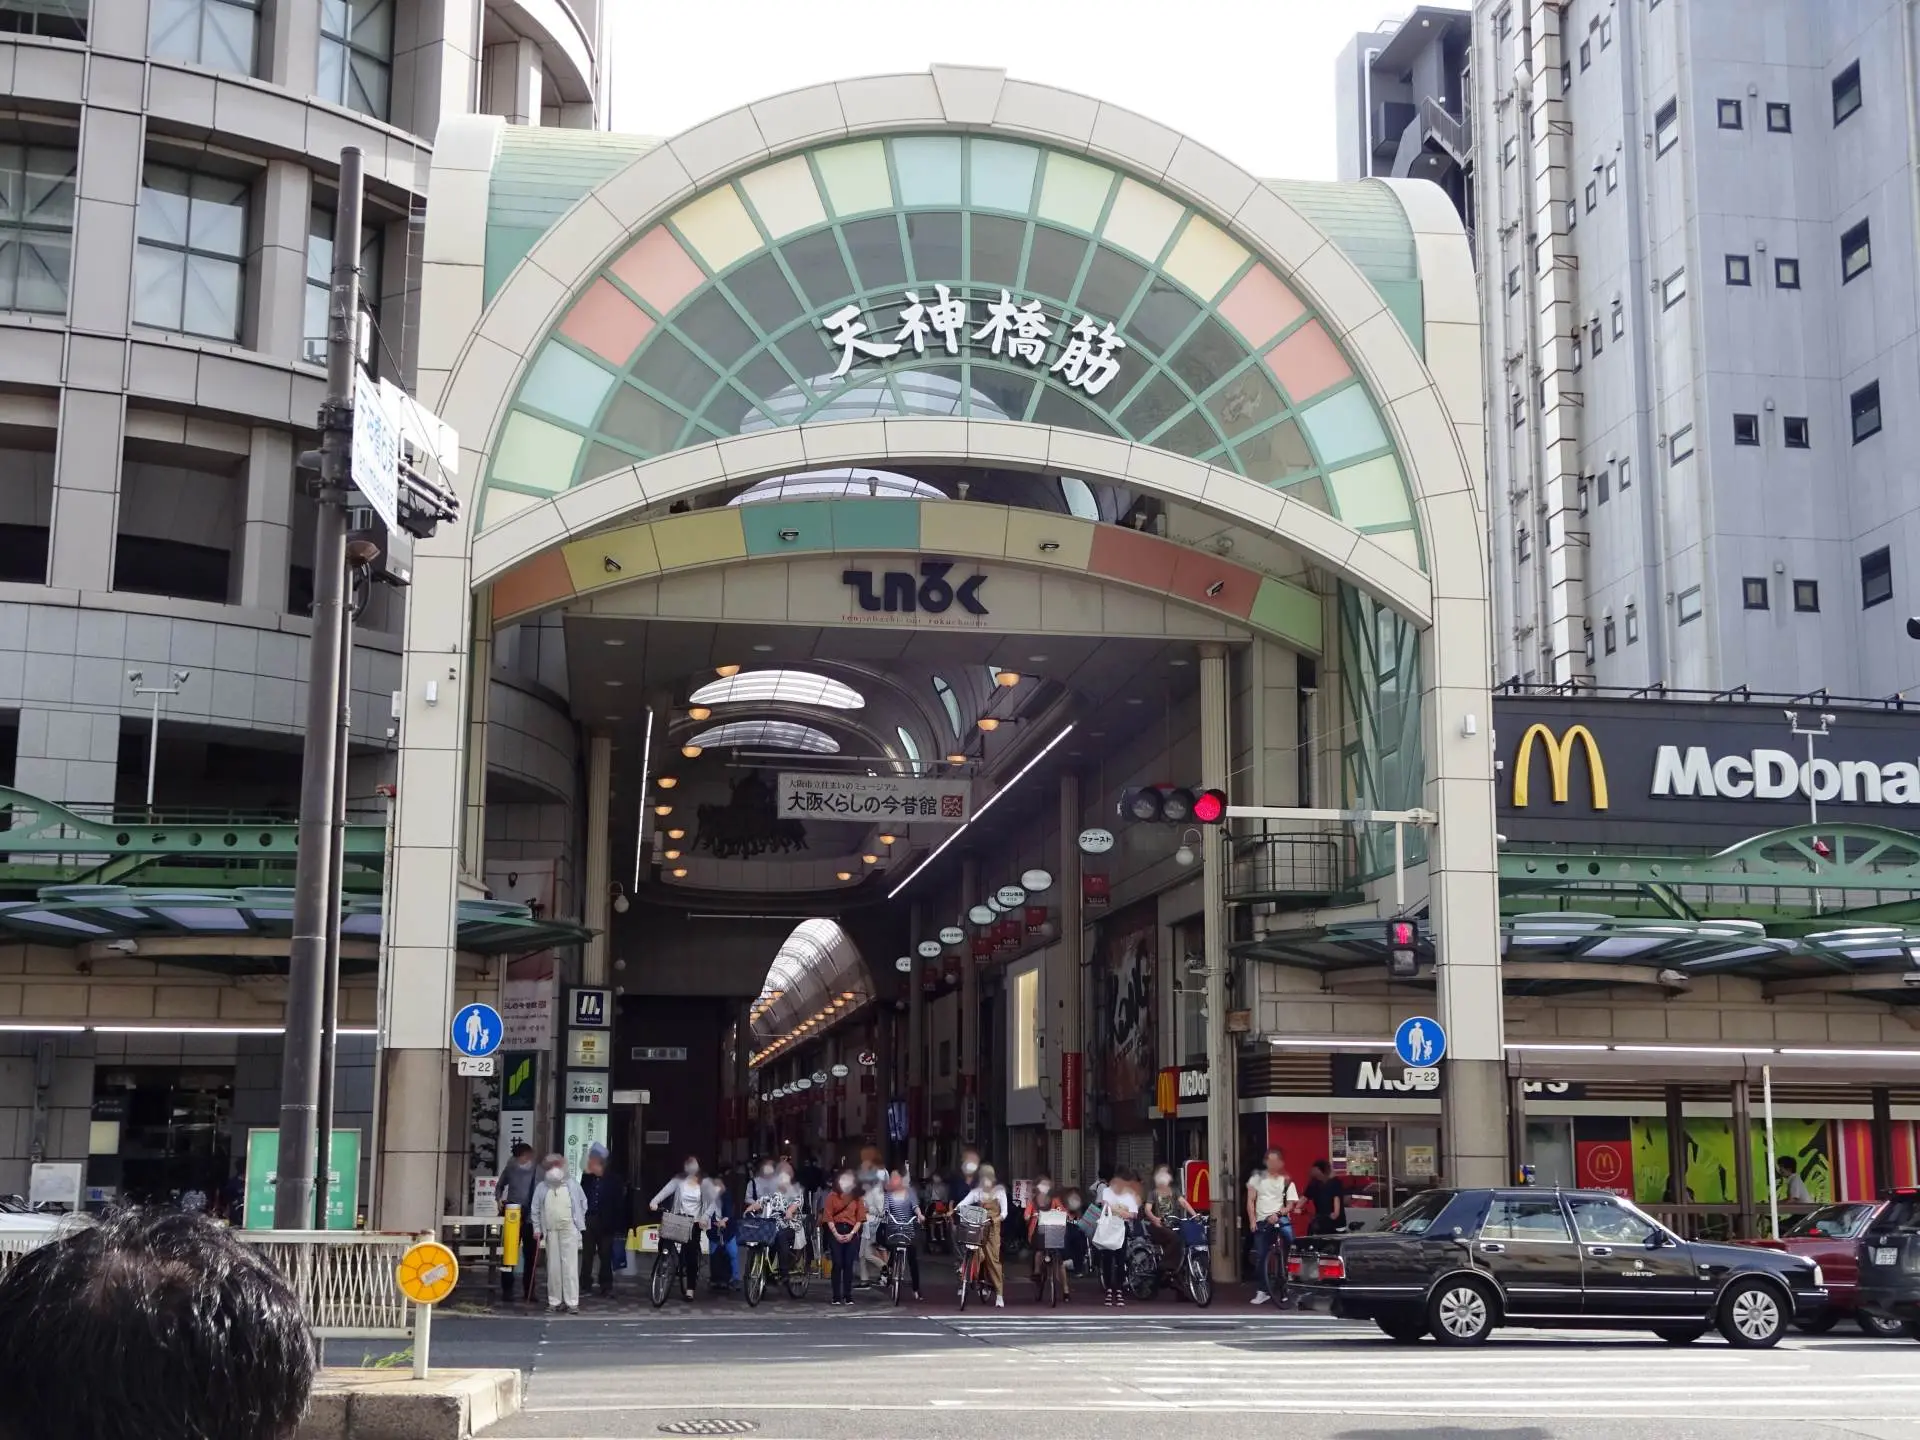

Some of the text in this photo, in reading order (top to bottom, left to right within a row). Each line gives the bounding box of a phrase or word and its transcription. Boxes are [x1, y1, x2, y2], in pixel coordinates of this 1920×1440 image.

[822, 284, 1126, 395] 天神橋筋
[1651, 745, 1920, 804] McDona
[788, 791, 937, 815] 大阪くらしの今昔館
[461, 1061, 491, 1072] 7-22
[1407, 1072, 1437, 1082] 7-22
